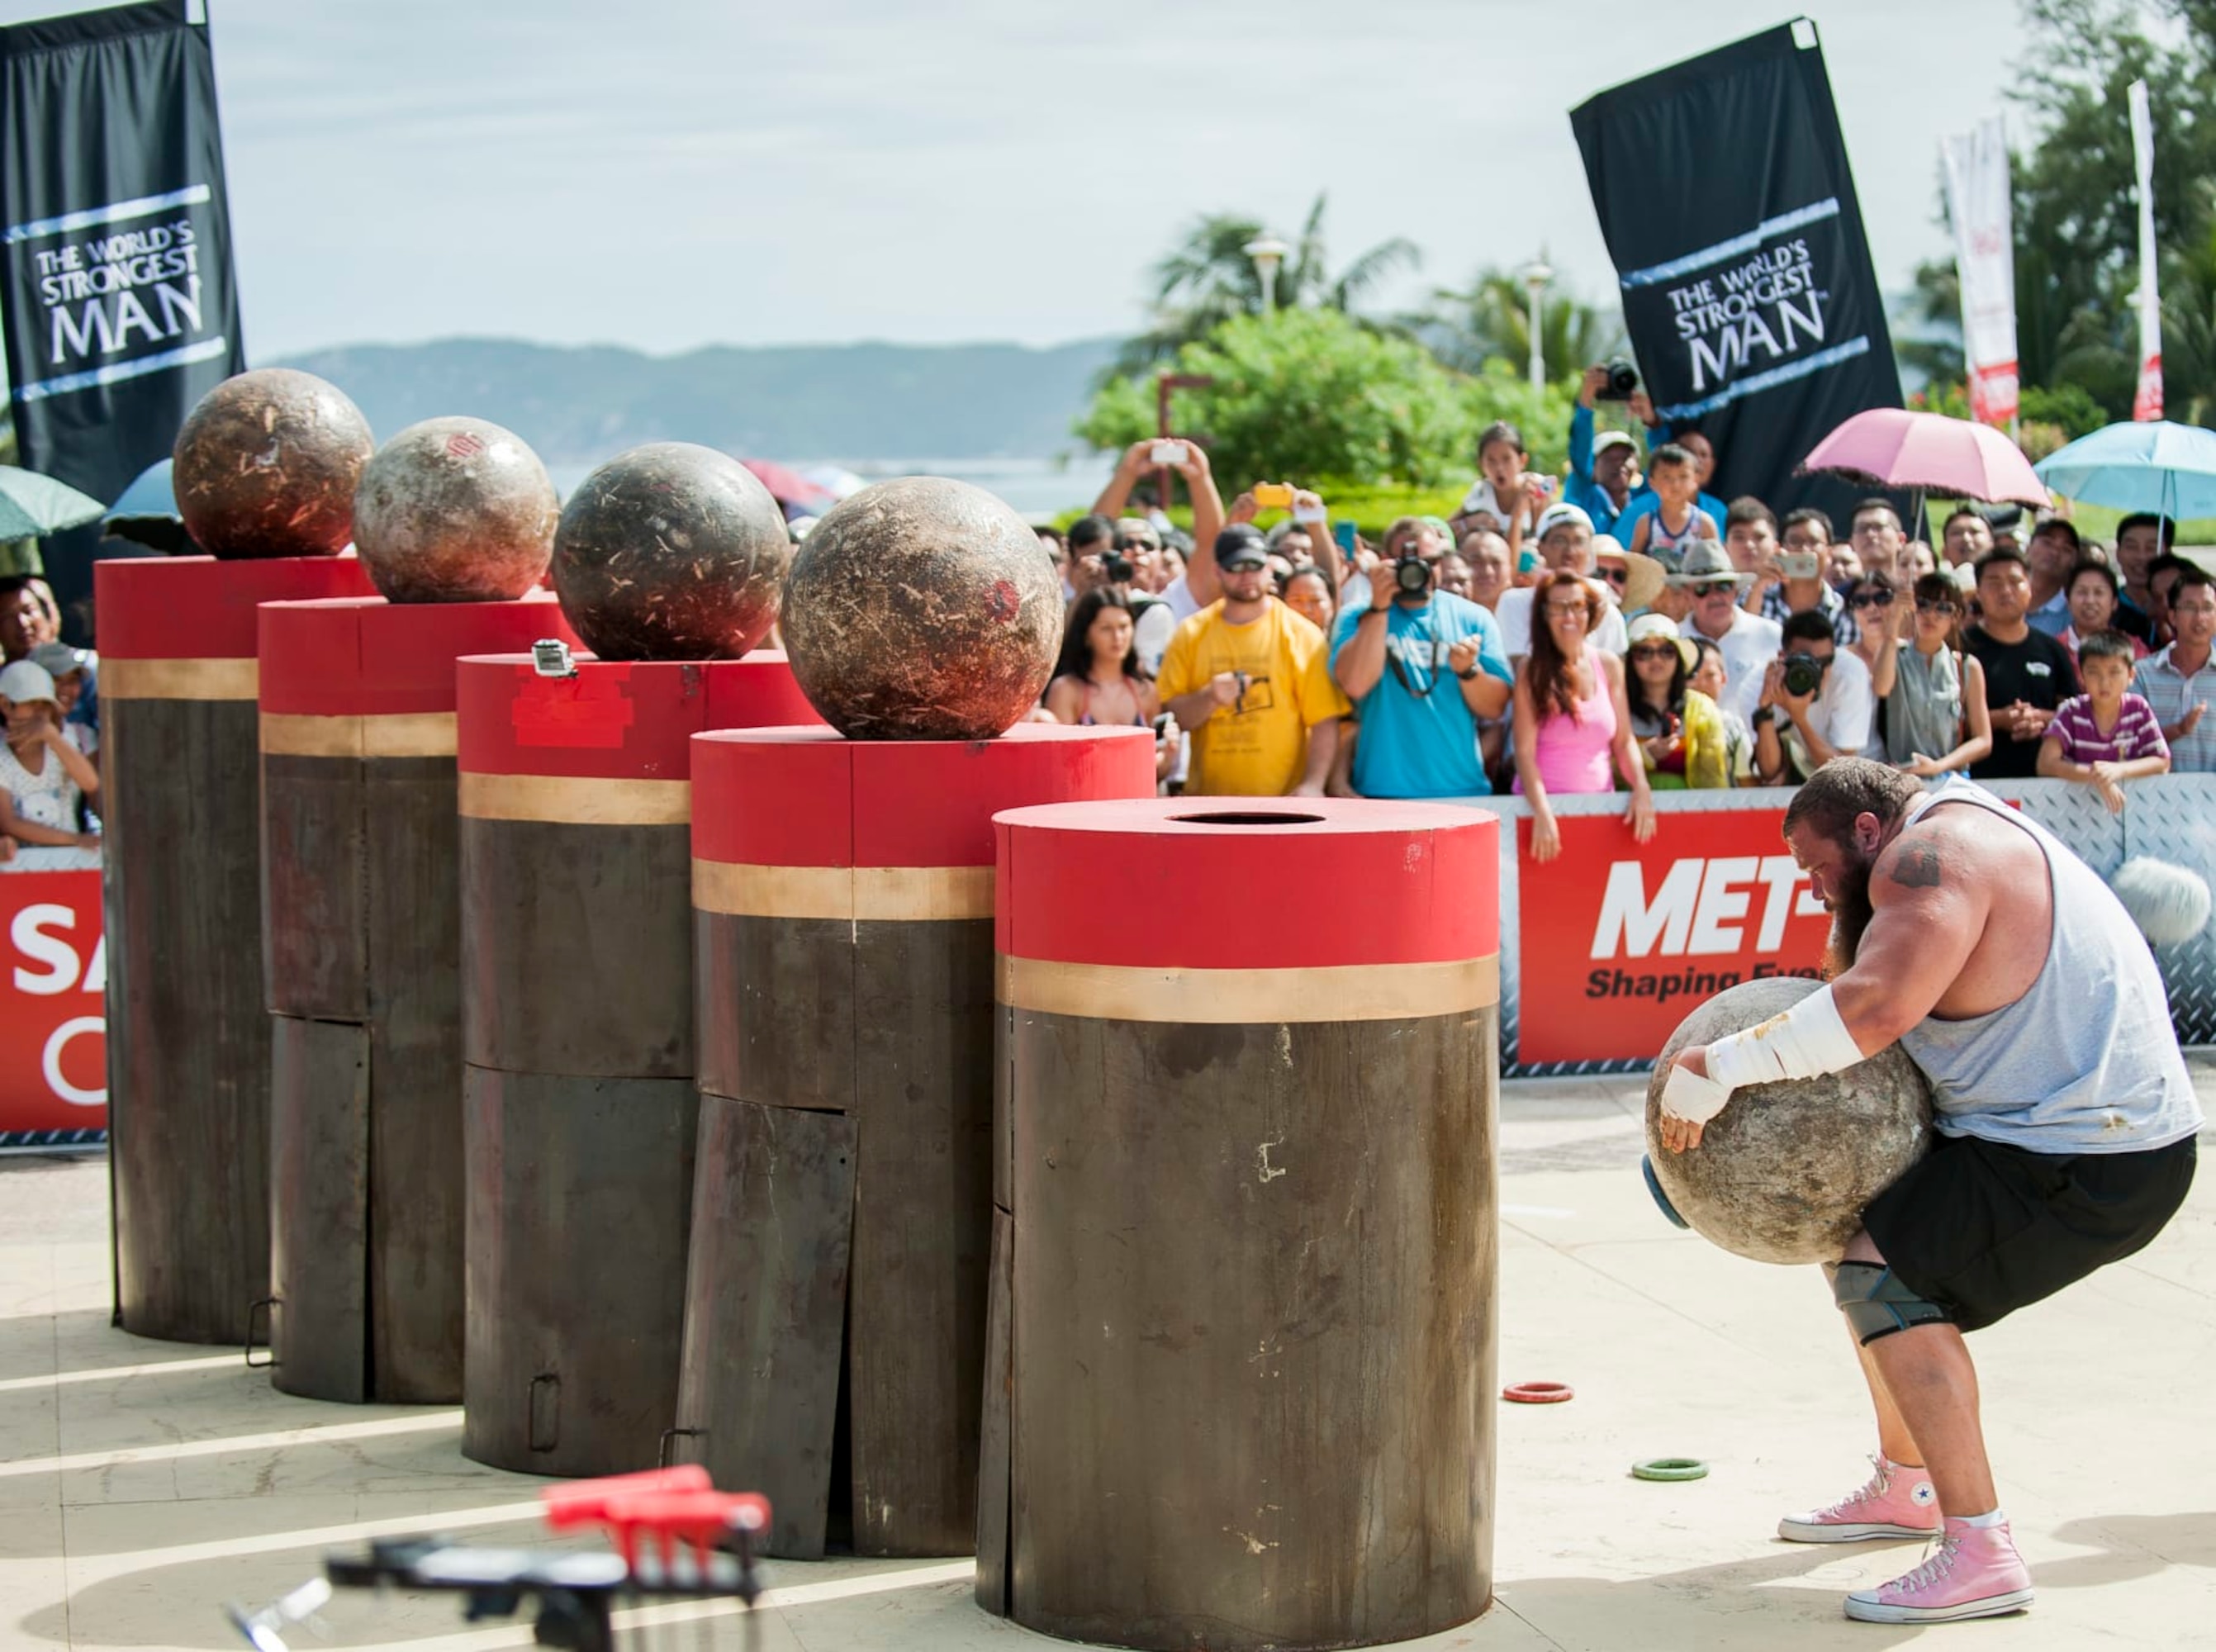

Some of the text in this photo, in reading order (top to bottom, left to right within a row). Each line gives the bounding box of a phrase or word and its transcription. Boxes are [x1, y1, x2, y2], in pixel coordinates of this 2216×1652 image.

[36, 220, 195, 275] THE WORLD'S
[41, 244, 199, 306] STRONGEST
[51, 273, 202, 363] MAN
[1668, 279, 1717, 312] THE
[1688, 288, 1825, 392] MAN
[10, 903, 107, 995] S
[1590, 855, 1835, 961] MET-
